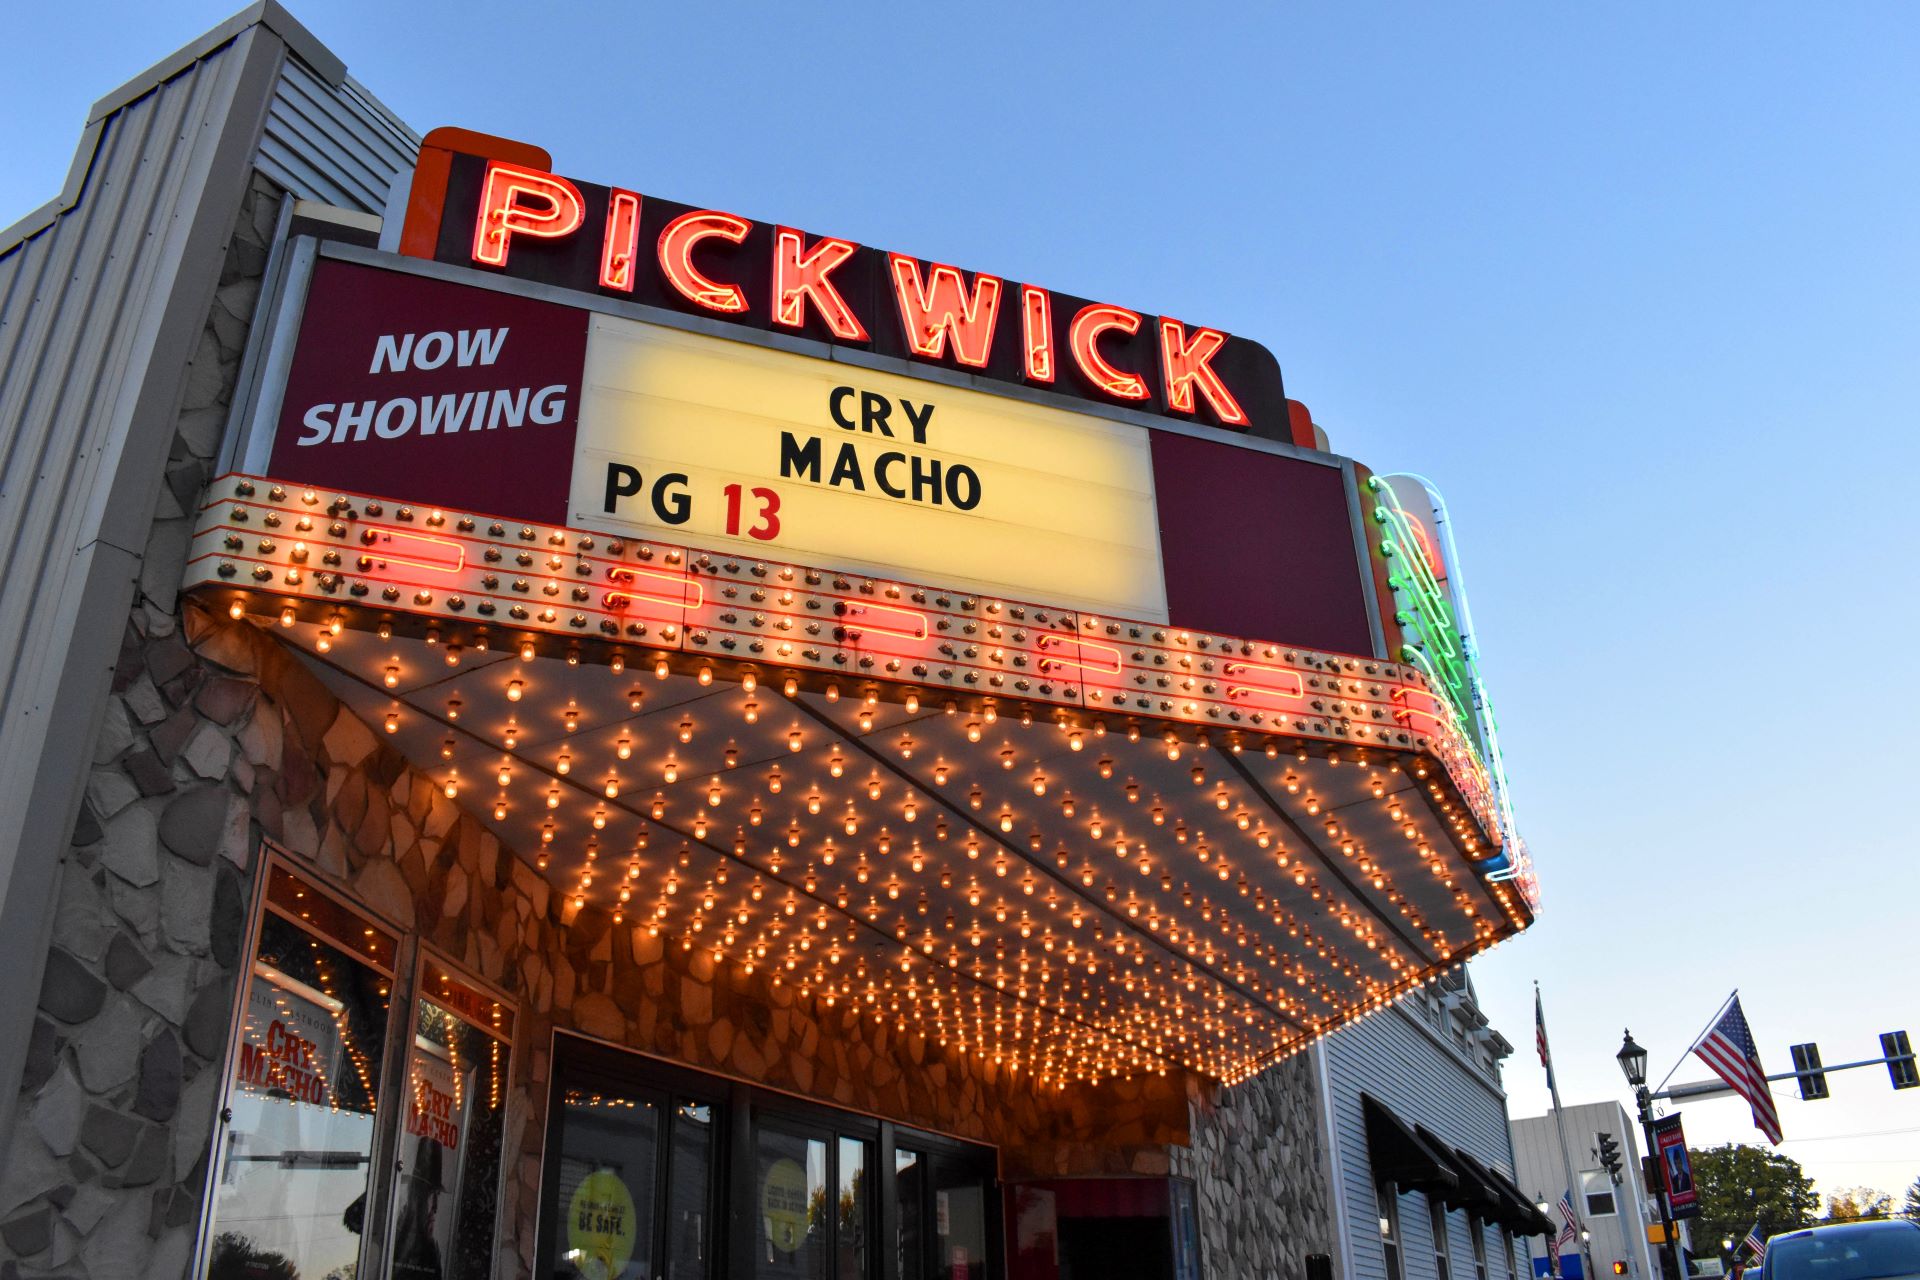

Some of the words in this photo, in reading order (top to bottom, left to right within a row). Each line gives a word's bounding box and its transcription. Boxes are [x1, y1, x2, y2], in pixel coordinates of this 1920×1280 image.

[471, 159, 1252, 429] PICKWICK
[369, 328, 510, 375] NOW
[297, 384, 569, 447] SHOWING
[829, 386, 935, 444] CRY
[604, 462, 692, 525] PG
[723, 484, 781, 541] 13
[780, 431, 982, 511] MACHO
[238, 1042, 323, 1104] MACHO
[267, 1019, 316, 1070] CRY
[418, 1079, 453, 1121] CRY
